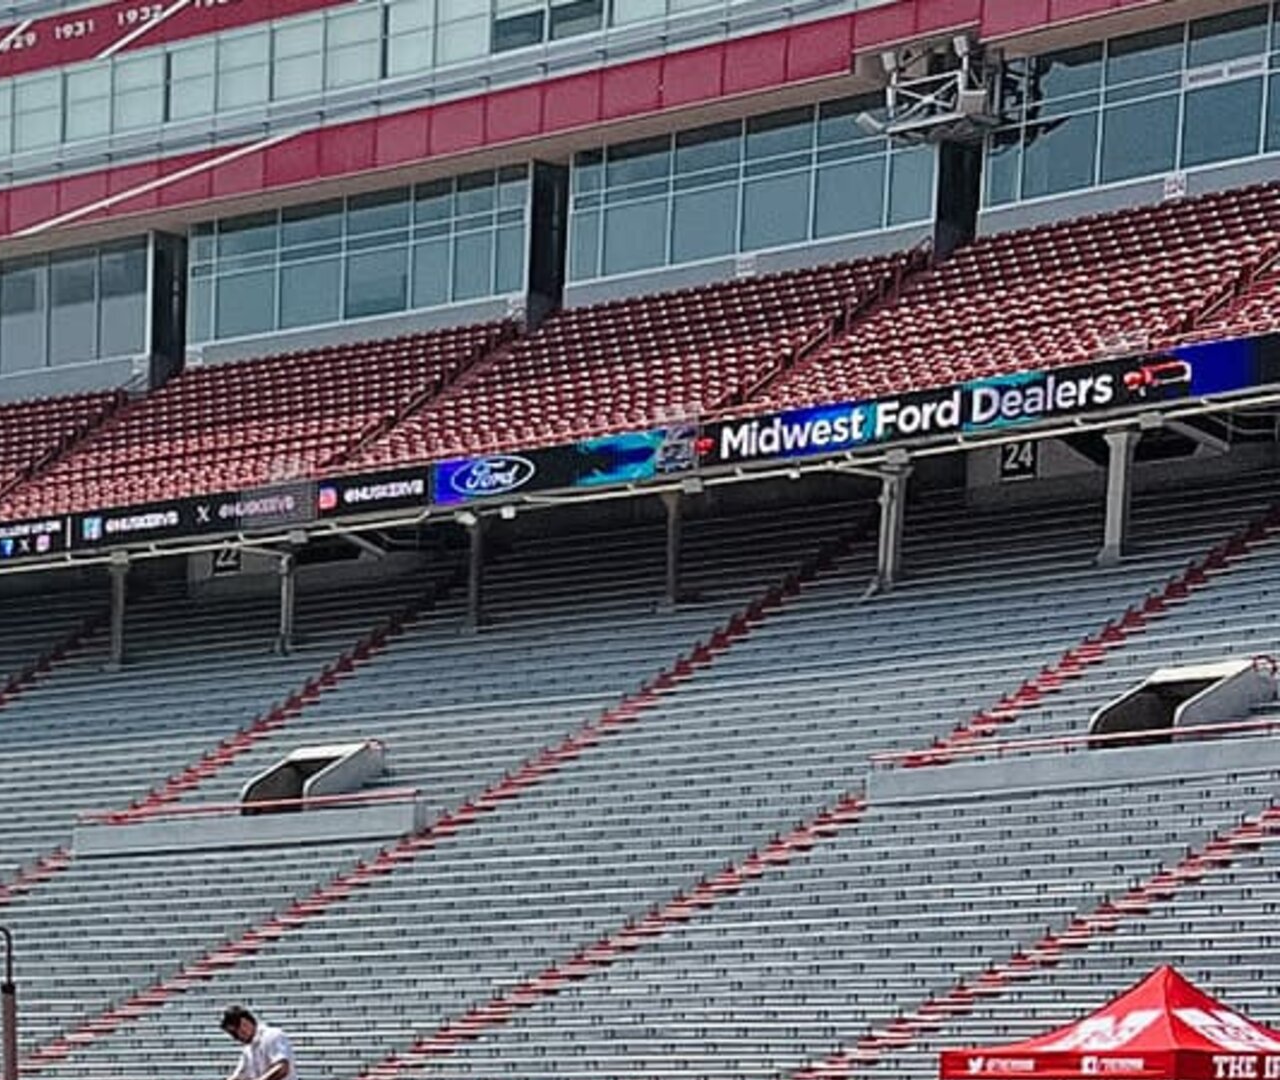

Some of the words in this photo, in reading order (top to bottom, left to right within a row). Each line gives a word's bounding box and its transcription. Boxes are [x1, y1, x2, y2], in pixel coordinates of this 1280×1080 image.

[54, 20, 95, 40] 1931
[720, 411, 865, 460] Midwest
[874, 391, 961, 437] Ford
[971, 372, 1114, 425] Dealers
[1003, 441, 1034, 470] 24
[464, 460, 521, 490] Ford
[1212, 1055, 1257, 1078] THE
